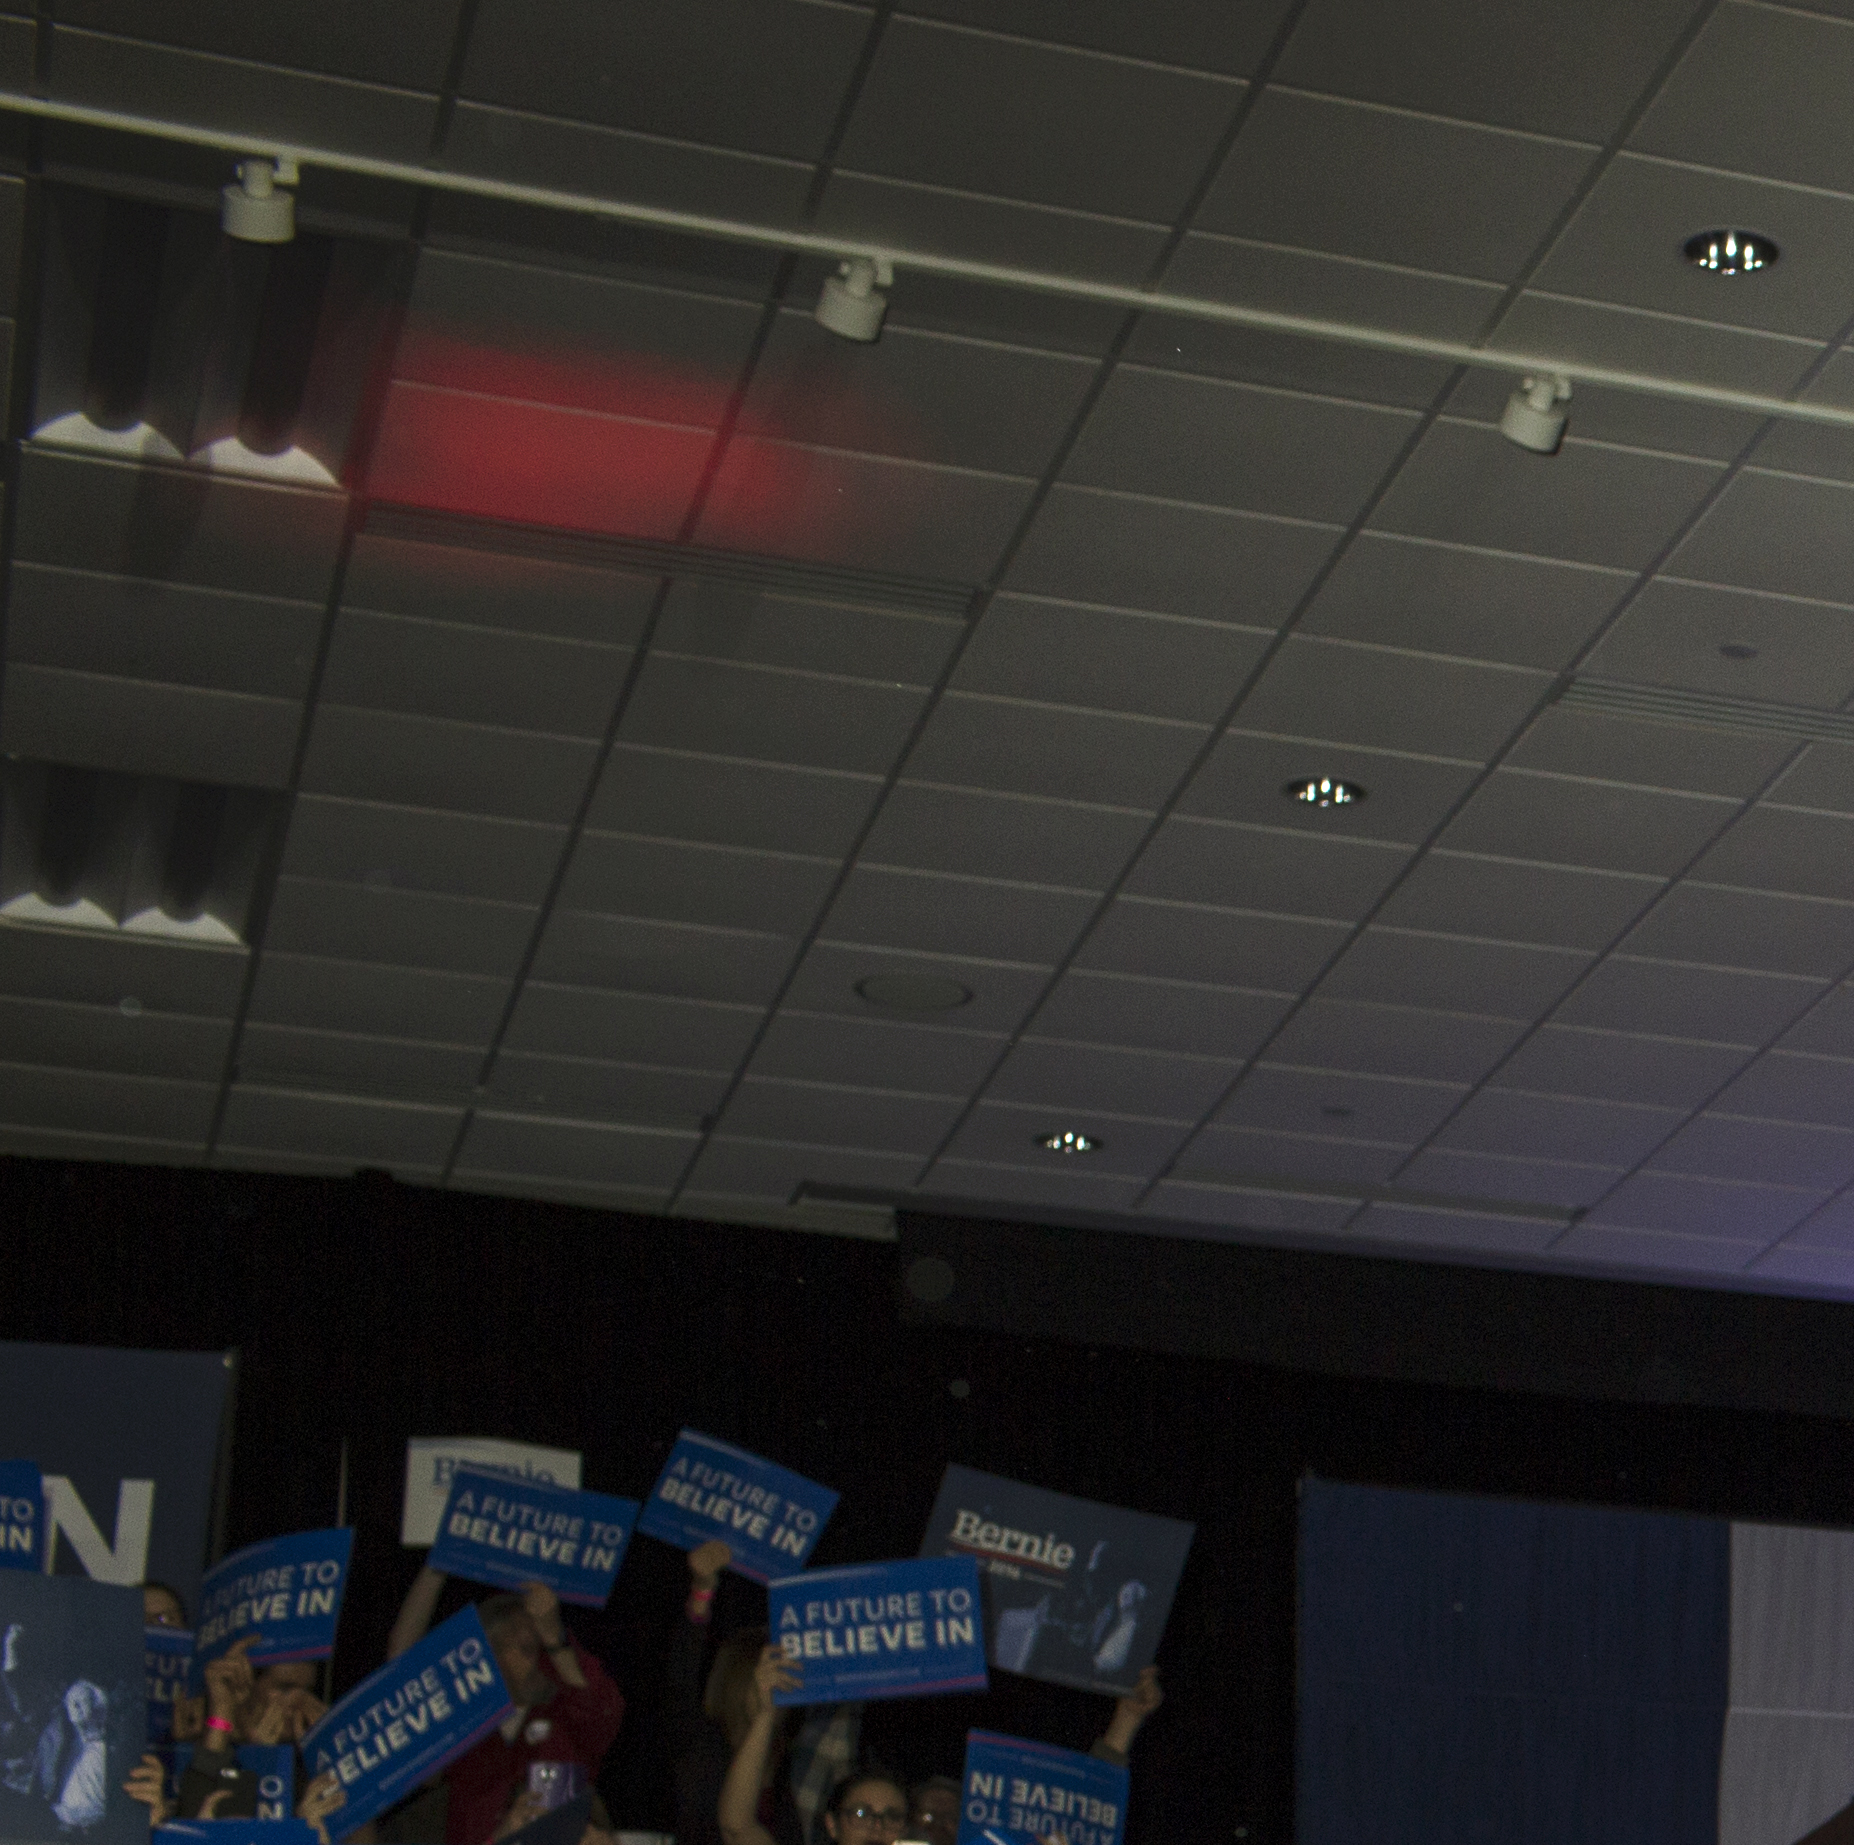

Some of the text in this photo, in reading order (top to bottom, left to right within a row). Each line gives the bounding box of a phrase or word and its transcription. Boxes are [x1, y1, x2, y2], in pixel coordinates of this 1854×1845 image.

[455, 1489, 623, 1547] A FUTURE TO
[659, 1476, 772, 1541] BELIEVE
[770, 1526, 808, 1557] IN
[671, 1456, 818, 1533] A FUTURE TO
[449, 1513, 617, 1572] BELIEVE IN
[953, 1508, 1076, 1570] Bernie
[300, 1558, 341, 1586] TO
[297, 1586, 336, 1617] IN
[780, 1587, 971, 1629] A FUTURE TO
[779, 1616, 975, 1658] BELIEVE IN
[314, 1749, 332, 1773] A
[332, 1665, 443, 1748] FUTURE
[438, 1637, 482, 1674] TO
[332, 1691, 454, 1786] ELIEVE
[454, 1659, 495, 1704] IN
[259, 1775, 284, 1799] O
[966, 1800, 1001, 1829] TO
[969, 1770, 1118, 1829] BELIEVE IN
